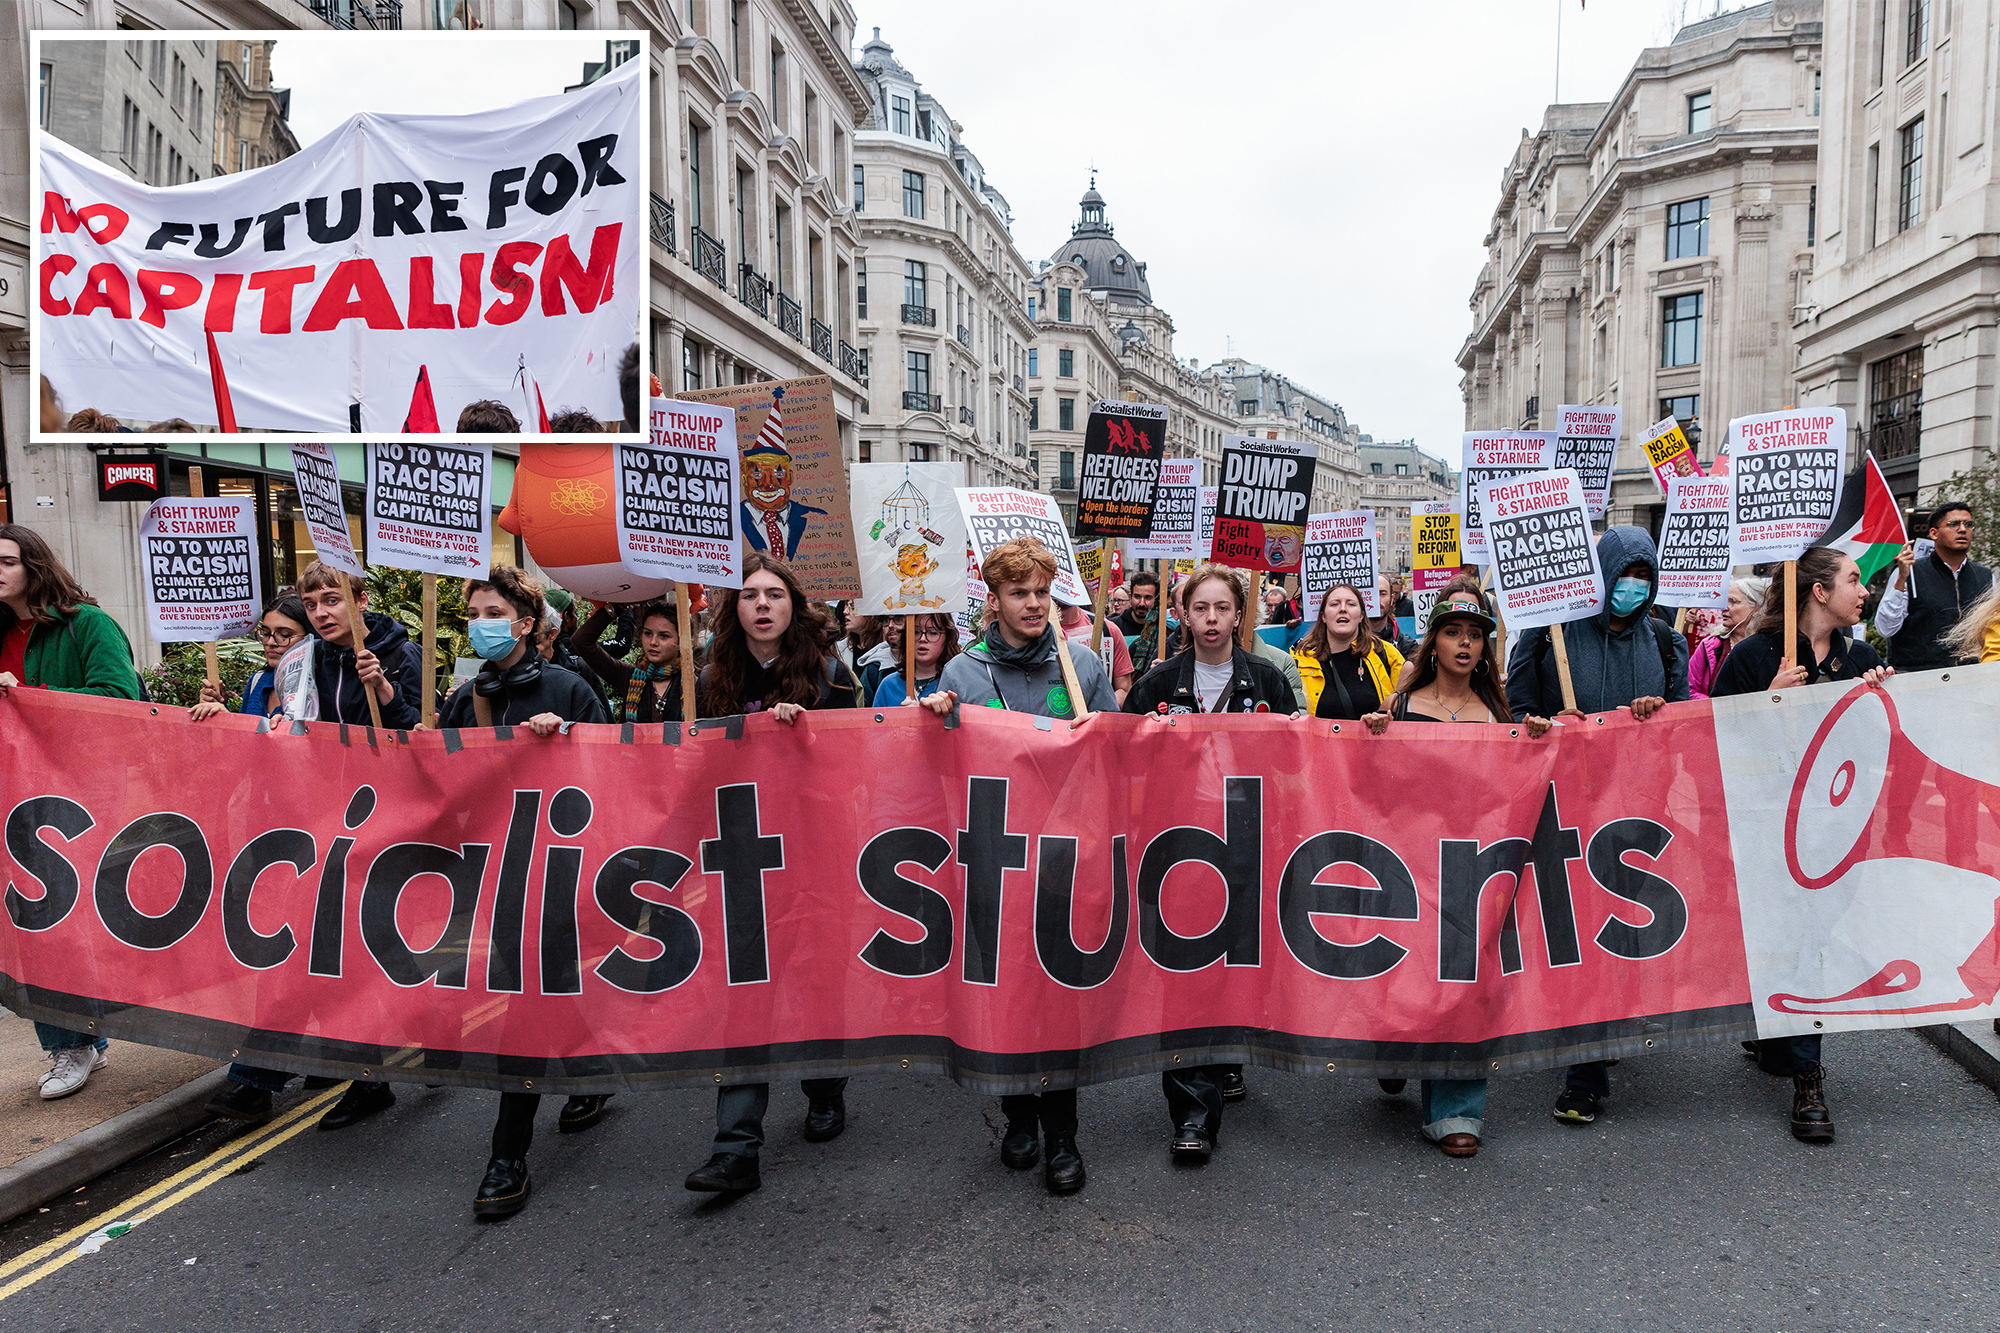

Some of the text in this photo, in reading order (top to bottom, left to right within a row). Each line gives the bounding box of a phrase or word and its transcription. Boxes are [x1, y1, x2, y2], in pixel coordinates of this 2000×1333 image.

[41, 133, 627, 258] NO FUTURE FOR
[40, 222, 623, 334] CAPITALISM
[708, 390, 730, 401] TRUMP
[731, 386, 762, 396] MOCKED
[785, 378, 826, 390] DISABLED
[668, 412, 723, 434] TRUMP
[1564, 412, 1616, 424] FIGHT TRUMP
[1742, 416, 1834, 438] FIGHT TRUMP
[1566, 424, 1612, 435] & STARMER
[650, 429, 717, 452] STARMER
[1472, 439, 1546, 450] FIGHT TRUMP
[1558, 440, 1614, 452] NO TO WAR
[1648, 432, 1676, 454] NO TO
[1748, 432, 1828, 452] & STARMER
[376, 443, 482, 474] NO TO WAR
[1477, 452, 1540, 464] & STARMER
[1555, 452, 1610, 468] RACISM
[1652, 439, 1686, 464] RACISM
[622, 449, 730, 480] NO TO WAR
[795, 462, 819, 471] TRUMP
[1085, 453, 1160, 482] REFUGEES
[1225, 452, 1298, 489] DUMP
[1658, 462, 1676, 478] NO
[1738, 452, 1837, 474] NO TO WAR
[108, 466, 154, 485] CAMPER
[378, 460, 480, 498] RACISM
[1740, 468, 1835, 494] RACISM
[625, 470, 729, 506] RACISM
[1082, 476, 1155, 504] WELCOME
[1489, 476, 1570, 502] FIGHT TRUMP
[1678, 485, 1706, 496] FIGHT
[377, 485, 478, 513] CLIMATE CHAOS
[625, 495, 728, 520] CLIMATE CHAOS
[968, 492, 1048, 508] FIGHT TRUMP
[1223, 484, 1306, 522] TRUMP
[1498, 492, 1570, 516] & STARMER
[1738, 490, 1833, 506] CLIMATE CHAOS
[150, 506, 240, 520] FIGHT TRUMP
[376, 500, 478, 529] CAPITALISM
[978, 503, 1048, 518] & STARMER
[1086, 500, 1149, 516] Open the borders
[1739, 502, 1832, 522] CAPITALISM
[158, 520, 236, 534] & STARMER
[626, 510, 729, 536] CAPITALISM
[972, 516, 1060, 534] NO TO WAR
[1084, 512, 1142, 528] No deportations
[1307, 516, 1367, 530] FIGHT TRUMP
[1425, 516, 1451, 528] STOP
[1492, 510, 1582, 540] NO TO WAR
[1669, 514, 1706, 528] NO TO
[379, 522, 404, 534] BUILD
[414, 528, 433, 539] NEW
[436, 532, 464, 543] PARTY
[466, 536, 478, 544] TO
[804, 532, 821, 540] WAS
[1218, 521, 1250, 540] Fight
[1311, 528, 1364, 540] & STARMER
[1420, 528, 1454, 542] RACIST
[1666, 528, 1730, 546] RACISM
[150, 540, 248, 554] NO TO WAR
[378, 532, 398, 541] GIVE
[400, 534, 442, 549] STUDENTS
[452, 543, 480, 554] VOICE
[1216, 538, 1261, 560] Bigotry
[1306, 540, 1371, 557] NO TO WAR
[1418, 541, 1456, 554] REFORM
[1496, 526, 1586, 561] RACISM
[1664, 547, 1730, 557] CLIMATE CHAOS
[152, 554, 248, 576] RACISM
[1306, 553, 1370, 572] RACISM
[1432, 554, 1445, 566] UK
[1500, 548, 1588, 573] CLIMATE CHAOS
[1661, 558, 1728, 570] CAPITALISM
[154, 574, 249, 586] CLIMATE CHAOS
[1308, 568, 1370, 580] CLIMATE CHAOS
[1424, 570, 1452, 580] Refugees
[1503, 558, 1590, 588] CAPITALISM
[156, 585, 250, 600] CAPITALISM
[1508, 579, 1592, 601] BUILD A NEW PARTY TO
[1508, 600, 1526, 609] GIVE
[1527, 593, 1565, 606] STUDENTS
[1573, 586, 1596, 597] VOICE
[4, 775, 1688, 993] socialist students
